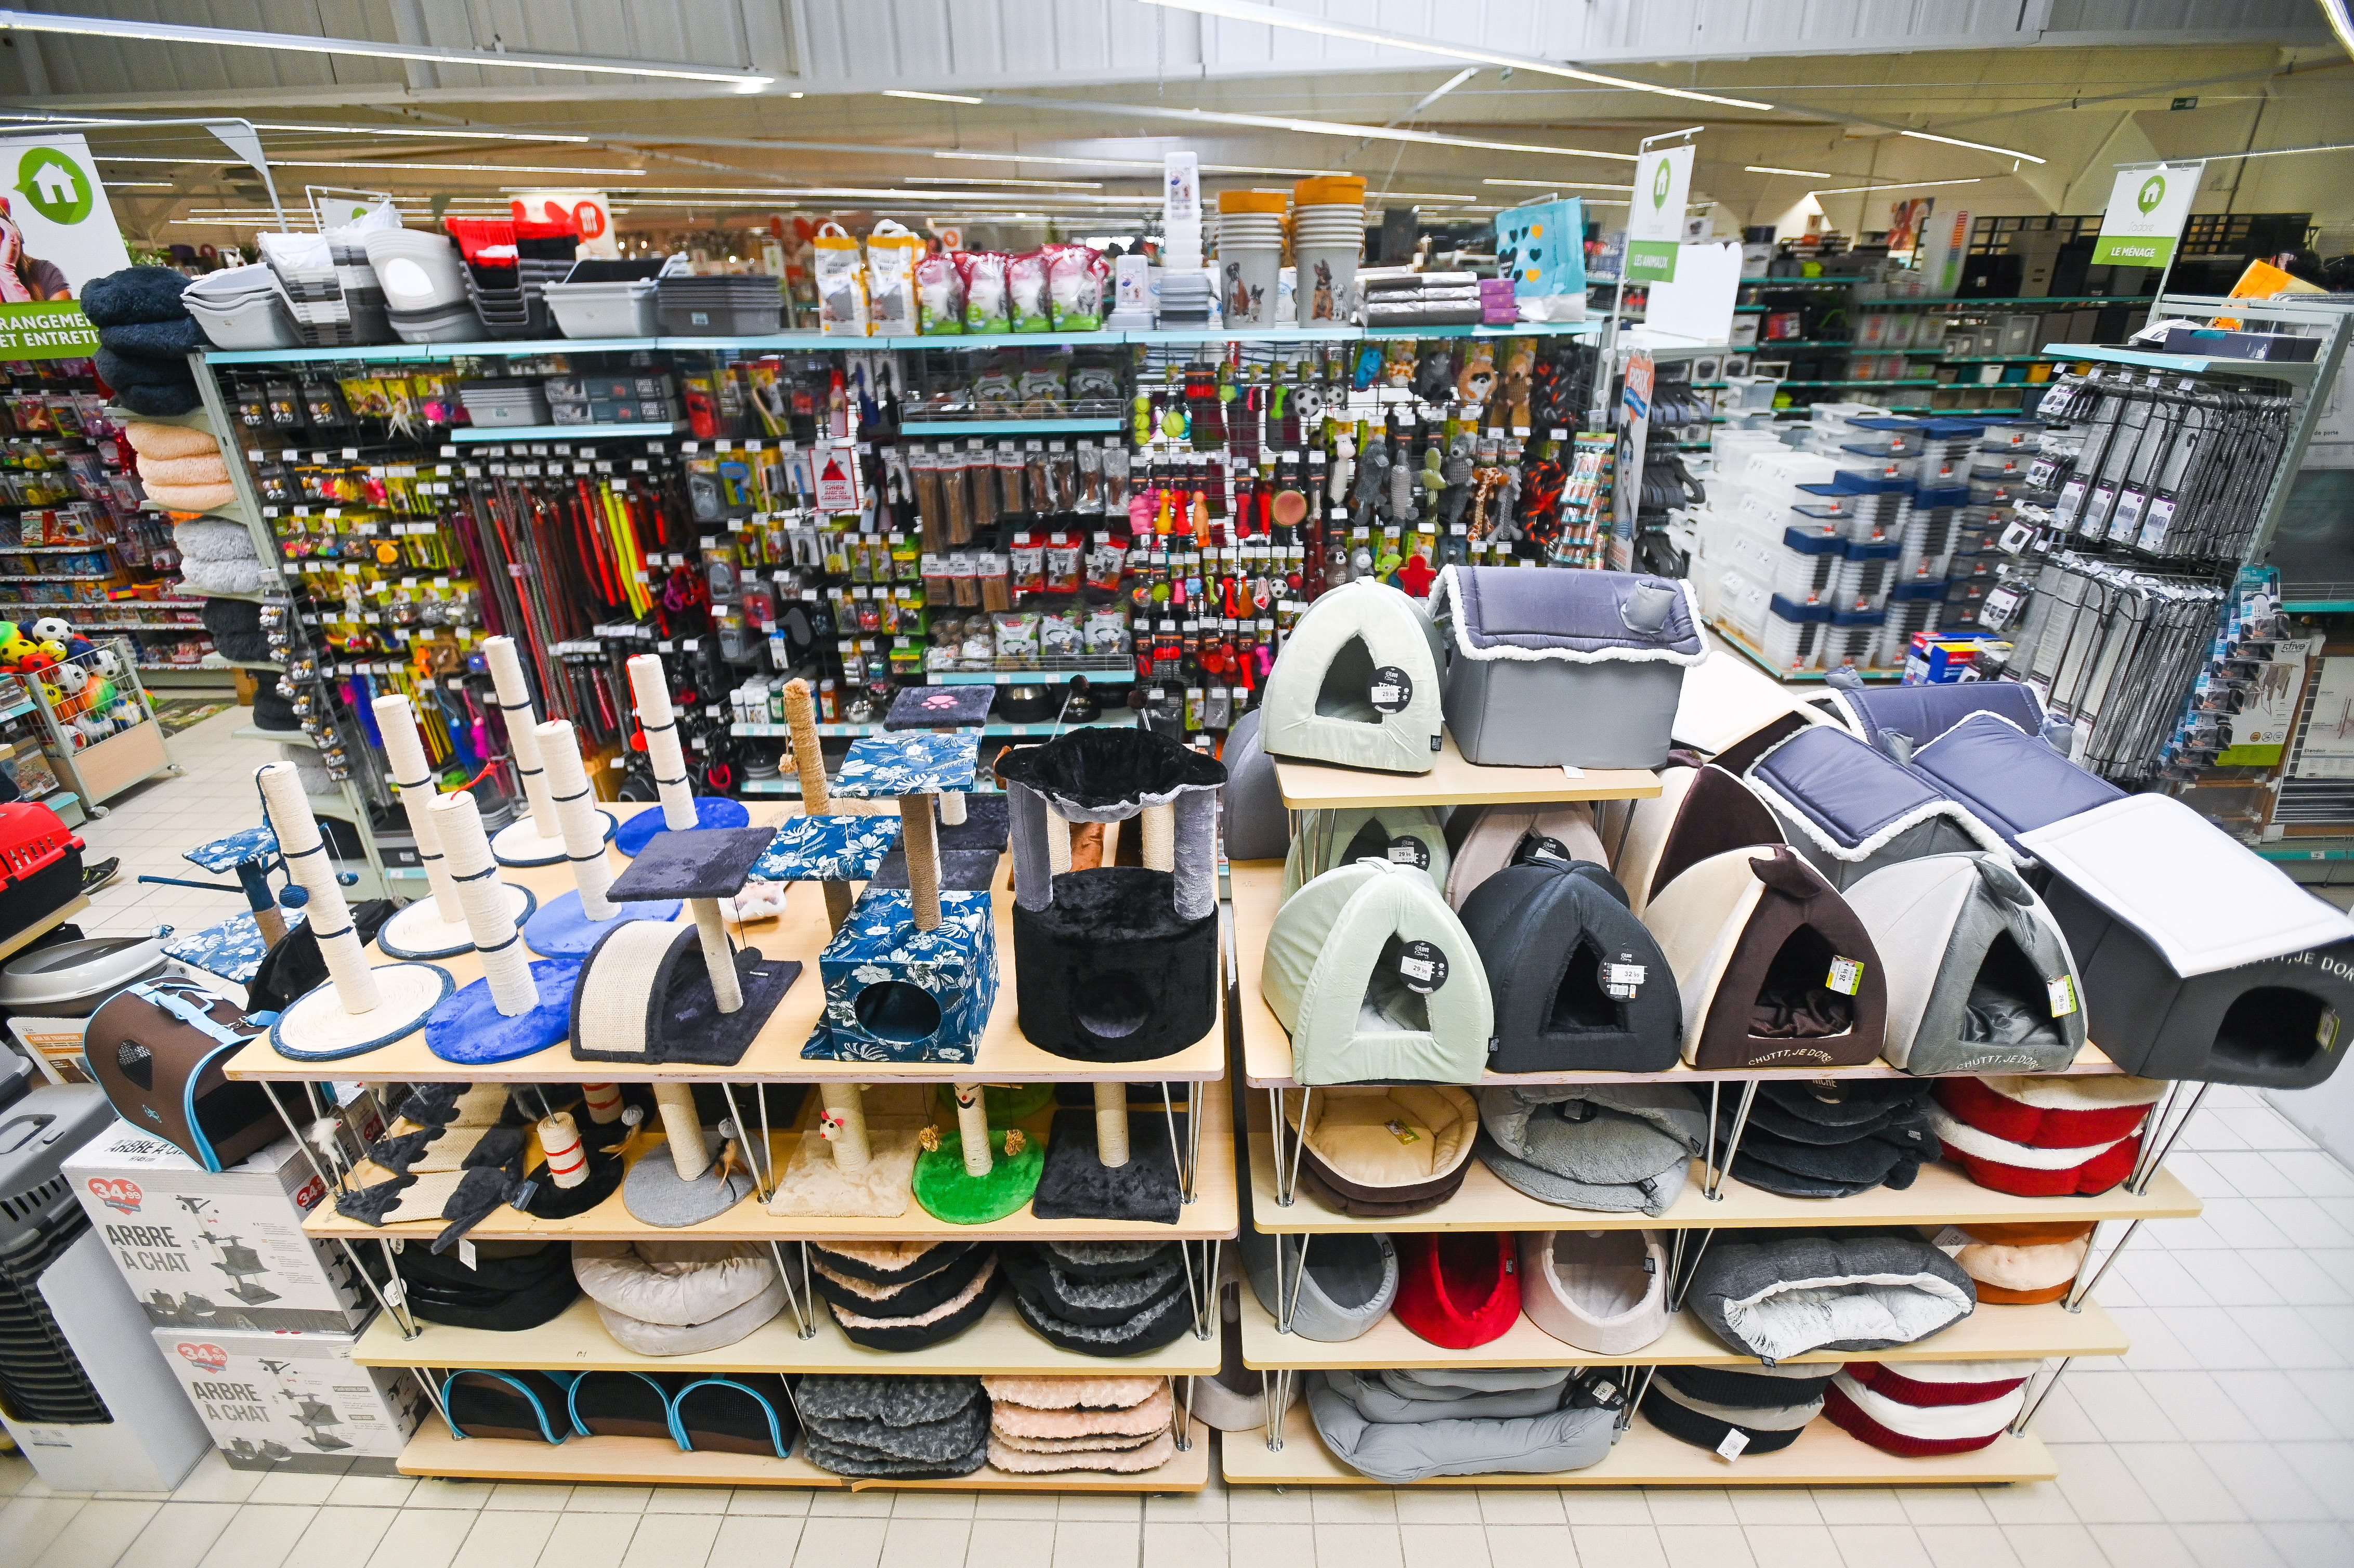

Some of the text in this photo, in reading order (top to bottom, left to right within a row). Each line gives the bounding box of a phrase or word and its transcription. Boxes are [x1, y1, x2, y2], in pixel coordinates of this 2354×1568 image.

[2111, 245, 2156, 257] LE MÉNAGE
[1642, 255, 1669, 268] ANIMAUX
[23, 330, 99, 346] ENTRETI
[1629, 367, 1650, 403] PRIX
[1748, 1050, 1791, 1065] CHUTTT,
[1957, 1055, 2002, 1069] CHUTTT,
[105, 1139, 154, 1154] ARBRE
[106, 1224, 181, 1247] ARBRE
[117, 1247, 192, 1272] À CHAT
[192, 1381, 263, 1402] ARBRE
[203, 1401, 271, 1422] À CHAT
